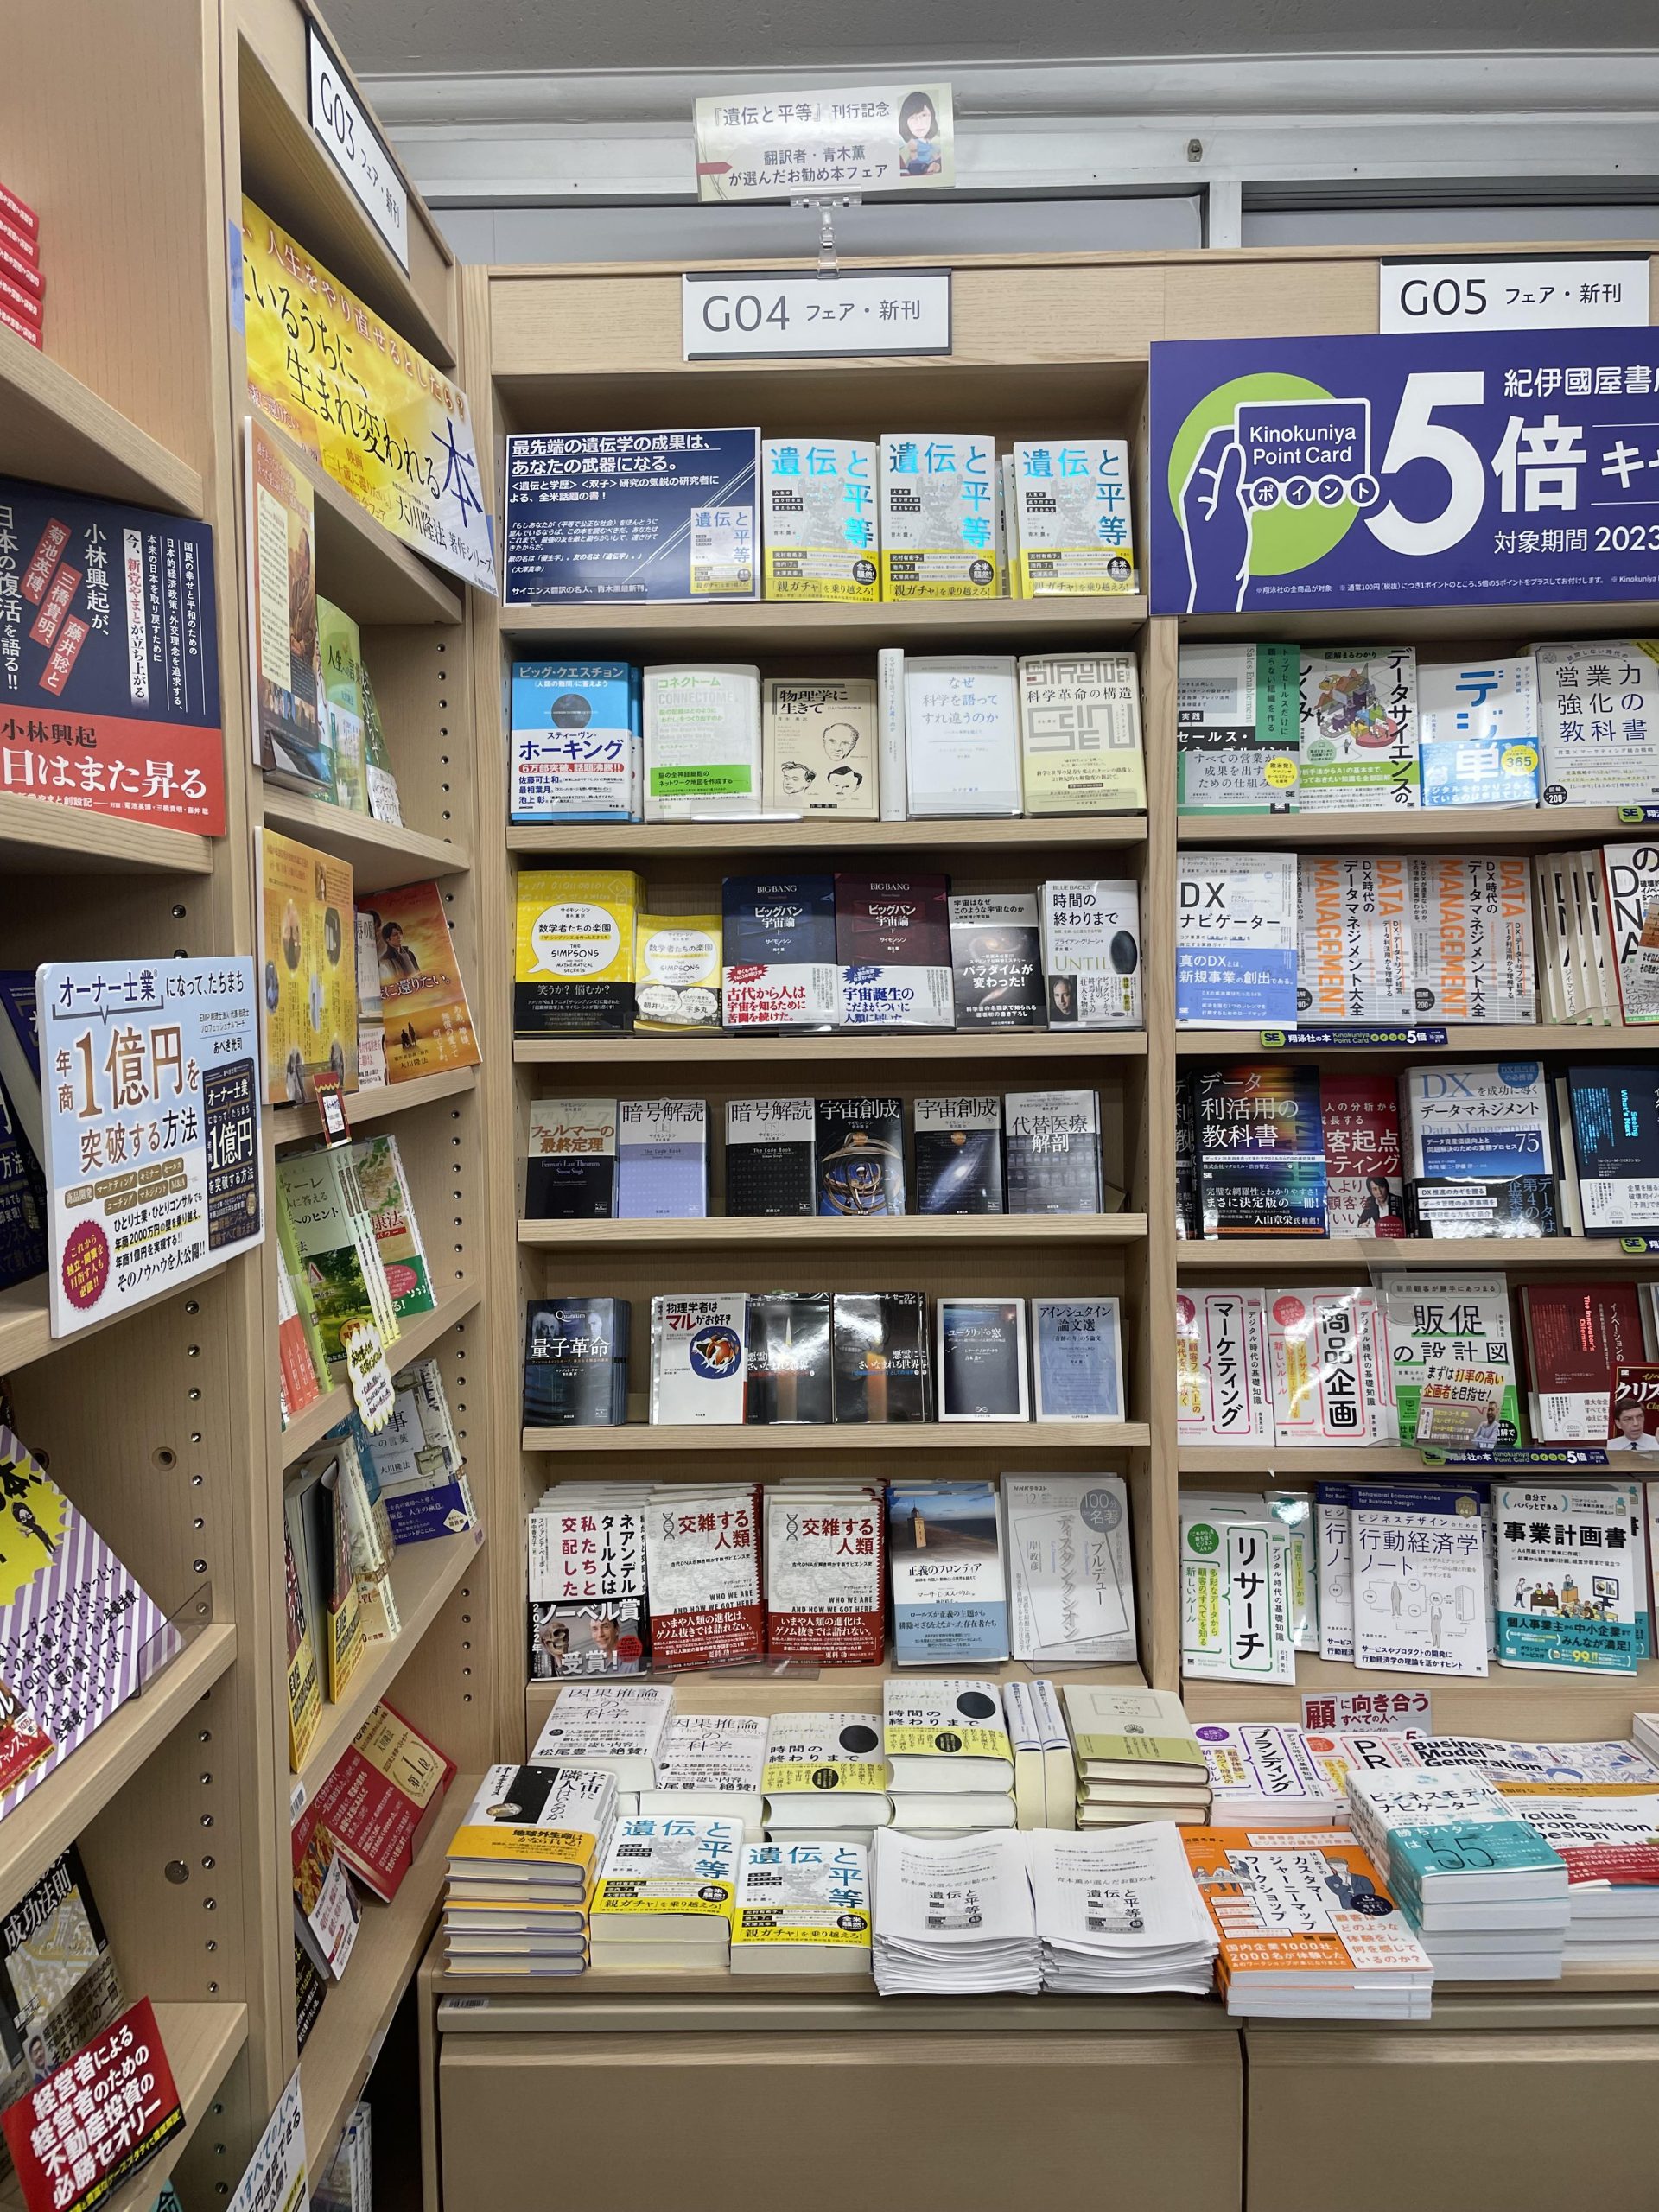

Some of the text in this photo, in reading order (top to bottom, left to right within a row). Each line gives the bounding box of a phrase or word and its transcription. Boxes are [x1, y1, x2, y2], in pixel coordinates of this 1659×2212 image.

[832, 102, 890, 119] 刊行記念
[321, 72, 401, 229] G03 フェア・新刊
[729, 164, 888, 187] が選んだお勧め本フェア
[1401, 279, 1622, 316] G05 フェア・新刊
[702, 296, 920, 332] G04 フェア・新刊
[1249, 423, 1357, 444] Kinokuniya
[512, 435, 710, 454] 最先端の遺伝学の成果は、
[512, 456, 677, 475] あなたの武器になる。
[1253, 446, 1352, 466] Point Card
[432, 417, 484, 528] 本
[1256, 476, 1374, 505] ポイント
[1494, 529, 1588, 554] 対象期間
[84, 523, 111, 636] 小林興起が、
[147, 534, 162, 662] 本来の日本を取り戻すために
[183, 542, 199, 656] 国民の幸せと平和のための
[520, 668, 624, 678] ビッグ・クエスチョン
[658, 677, 721, 689] コネクトーム
[949, 677, 975, 689] なぜ
[1555, 664, 1641, 688] 営業力
[779, 690, 849, 702] 物理学に
[923, 694, 998, 707] 科学を語って
[1027, 686, 1133, 703] 科学革命の構造
[1281, 648, 1289, 736] トップセールスだけに
[1557, 693, 1644, 715] 強化の
[922, 712, 999, 725] すれ違うのか
[1, 718, 98, 748] 小林興起
[1559, 719, 1648, 742] 教科書
[519, 739, 624, 760] ホーキング
[1506, 756, 1532, 767] 365
[1, 747, 207, 799] 日はまた昇る
[1180, 882, 1225, 908] DX
[1485, 862, 1497, 914] DX時代の
[1053, 893, 1096, 908] 時間の
[755, 906, 804, 917] ビッグバン
[875, 916, 909, 927] 宇宙論
[1053, 912, 1119, 926] 終わりまで
[1180, 914, 1281, 929] ナビゲーター
[539, 924, 612, 933] 数学者たちの楽園
[762, 917, 796, 928] 宇宙論
[1438, 860, 1466, 1018] MANAGEMENT
[1468, 861, 1486, 1018] データマネジメント大全
[973, 977, 1026, 988] 変わった!
[727, 1001, 806, 1012] 宇宙を知るために
[213, 1037, 243, 1055] あべき光司
[1264, 1032, 1332, 1043] SE 翔泳社の本
[1406, 1029, 1427, 1044] 5倍
[55, 1050, 74, 1113] 年商
[1200, 1072, 1262, 1095] データ
[208, 1079, 249, 1107] オーナー士業
[622, 1102, 704, 1123] 暗号解読
[731, 1100, 813, 1123] 暗号解読
[819, 1099, 900, 1120] 宇宙創成
[917, 1098, 998, 1119] 宇宙創成
[1200, 1096, 1299, 1121] 利活用の
[1421, 1102, 1540, 1119] データマネジメント
[1012, 1114, 1088, 1135] 代替医療
[80, 1106, 199, 1173] 突破する方法
[540, 1137, 604, 1154] 最終定理
[1202, 1124, 1279, 1148] 教科書
[1326, 1129, 1399, 1153] 客起点
[208, 1167, 254, 1195] を突破する方法
[106, 1192, 136, 1211] コーチング
[666, 1302, 718, 1313] 物理学者は
[1039, 1306, 1111, 1319] アインシュタイン
[1414, 1304, 1485, 1336] 販促
[948, 1328, 1001, 1338] ユークリッドの窓
[531, 1336, 610, 1359] 量子革命
[1214, 1302, 1243, 1427] マーケティング
[1322, 1305, 1357, 1427] 商品企画
[1360, 1311, 1376, 1406] デジタル時代の基礎知識
[1427, 1365, 1504, 1384] まずは打率の高い
[1567, 1452, 1587, 1463] 5倍
[1525, 1493, 1546, 1502] 自分で
[678, 1510, 749, 1535] 交雑する
[802, 1518, 874, 1537] 交雑する
[714, 1530, 750, 1551] 人類
[836, 1537, 874, 1555] 人類
[1359, 1528, 1478, 1556] 行動経済学
[1503, 1522, 1627, 1549] 事業計画書
[908, 1563, 982, 1577] 正義のフロンティア
[1361, 1554, 1413, 1577] ノート
[1186, 1567, 1197, 1623] 新しいルール
[1233, 1537, 1264, 1660] リサーチ
[1273, 1547, 1284, 1641] デジタル時代の基礎知識
[540, 1599, 641, 1625] ノーベル賞
[531, 1604, 543, 1653] 2022年
[569, 1688, 659, 1699] 因果推論
[582, 1709, 630, 1719] 科学
[1341, 1714, 1398, 1725] すべての人へ
[770, 1745, 823, 1753] 時間の
[1412, 1739, 1507, 1752] Business
[1420, 1749, 1487, 1759] Model
[769, 1754, 861, 1763] 終わりまで
[1425, 1758, 1545, 1772] Generation
[546, 1770, 576, 1821] 隣人はいるのか
[580, 1771, 606, 1800] 宇宙に
[1370, 1789, 1497, 1802] ビジネスモデル
[1378, 1802, 1480, 1813] ナビゲーター
[1293, 1857, 1323, 1901] カスタマー
[3, 1872, 73, 1951] 成功法則
[1225, 1943, 1338, 1953] 国内企業1000社、
[1230, 1951, 1345, 1961] 2000名が体験した
[32, 2024, 134, 2121] 経営者による
[30, 2044, 149, 2157] 経営者のための
[53, 2099, 162, 2209] 必勝セオリー
